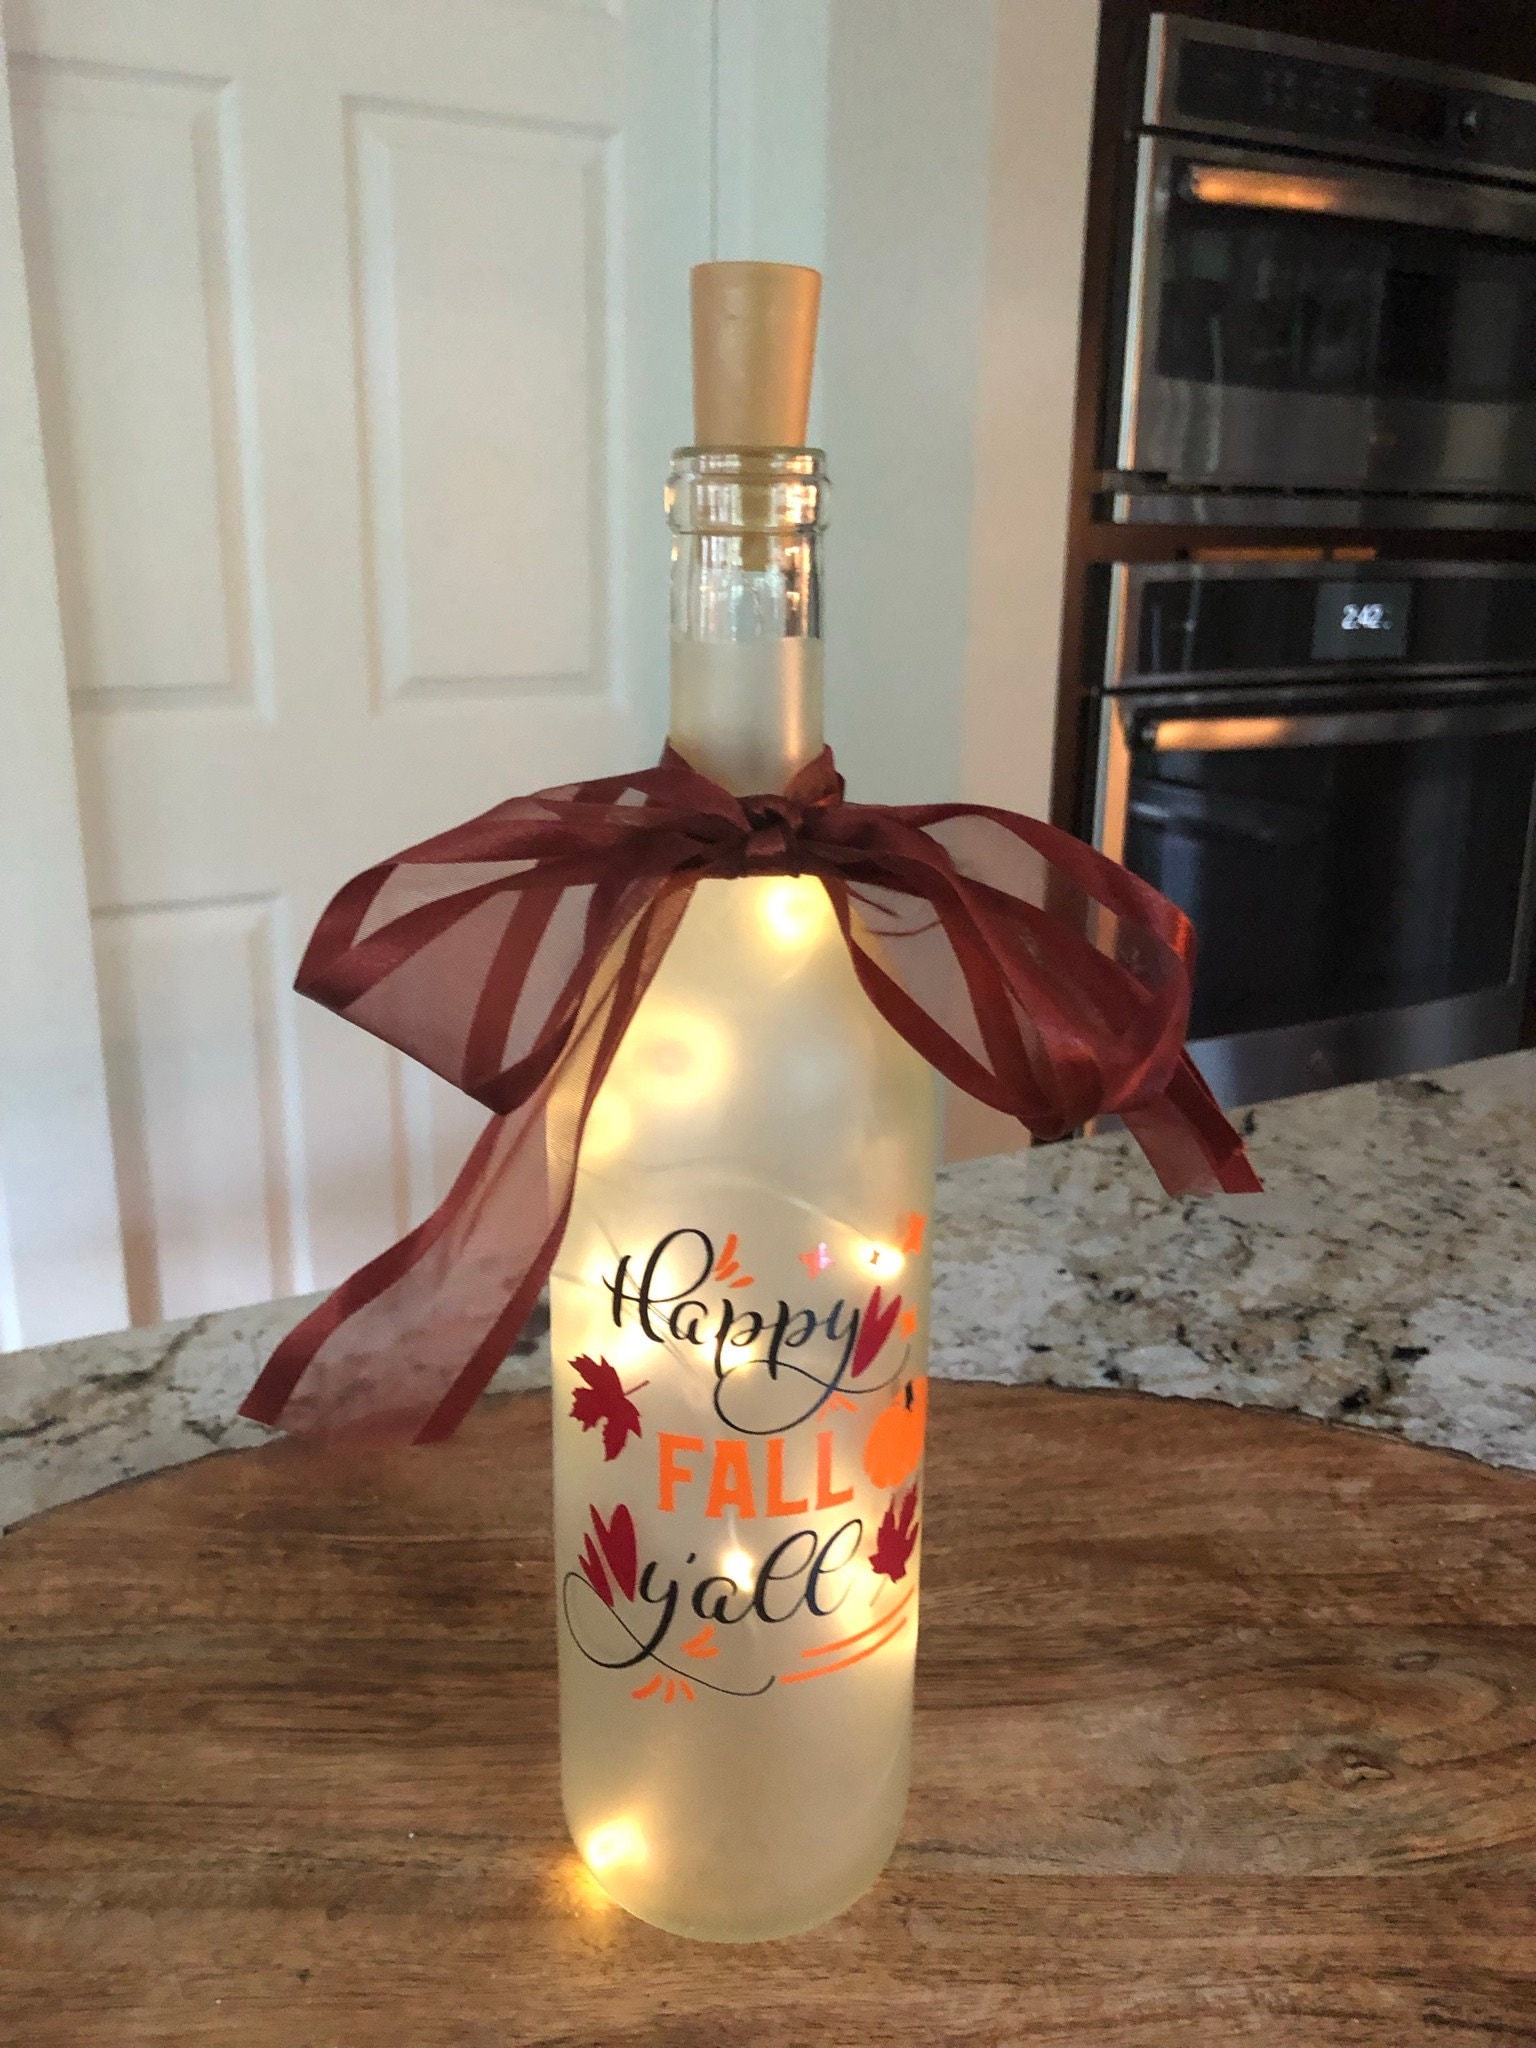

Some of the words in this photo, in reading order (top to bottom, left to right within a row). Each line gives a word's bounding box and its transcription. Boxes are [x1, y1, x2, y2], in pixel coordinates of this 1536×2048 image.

[602, 1228, 909, 1435] Happy
[657, 1431, 854, 1519] FALL
[563, 1519, 863, 1697] y'all
